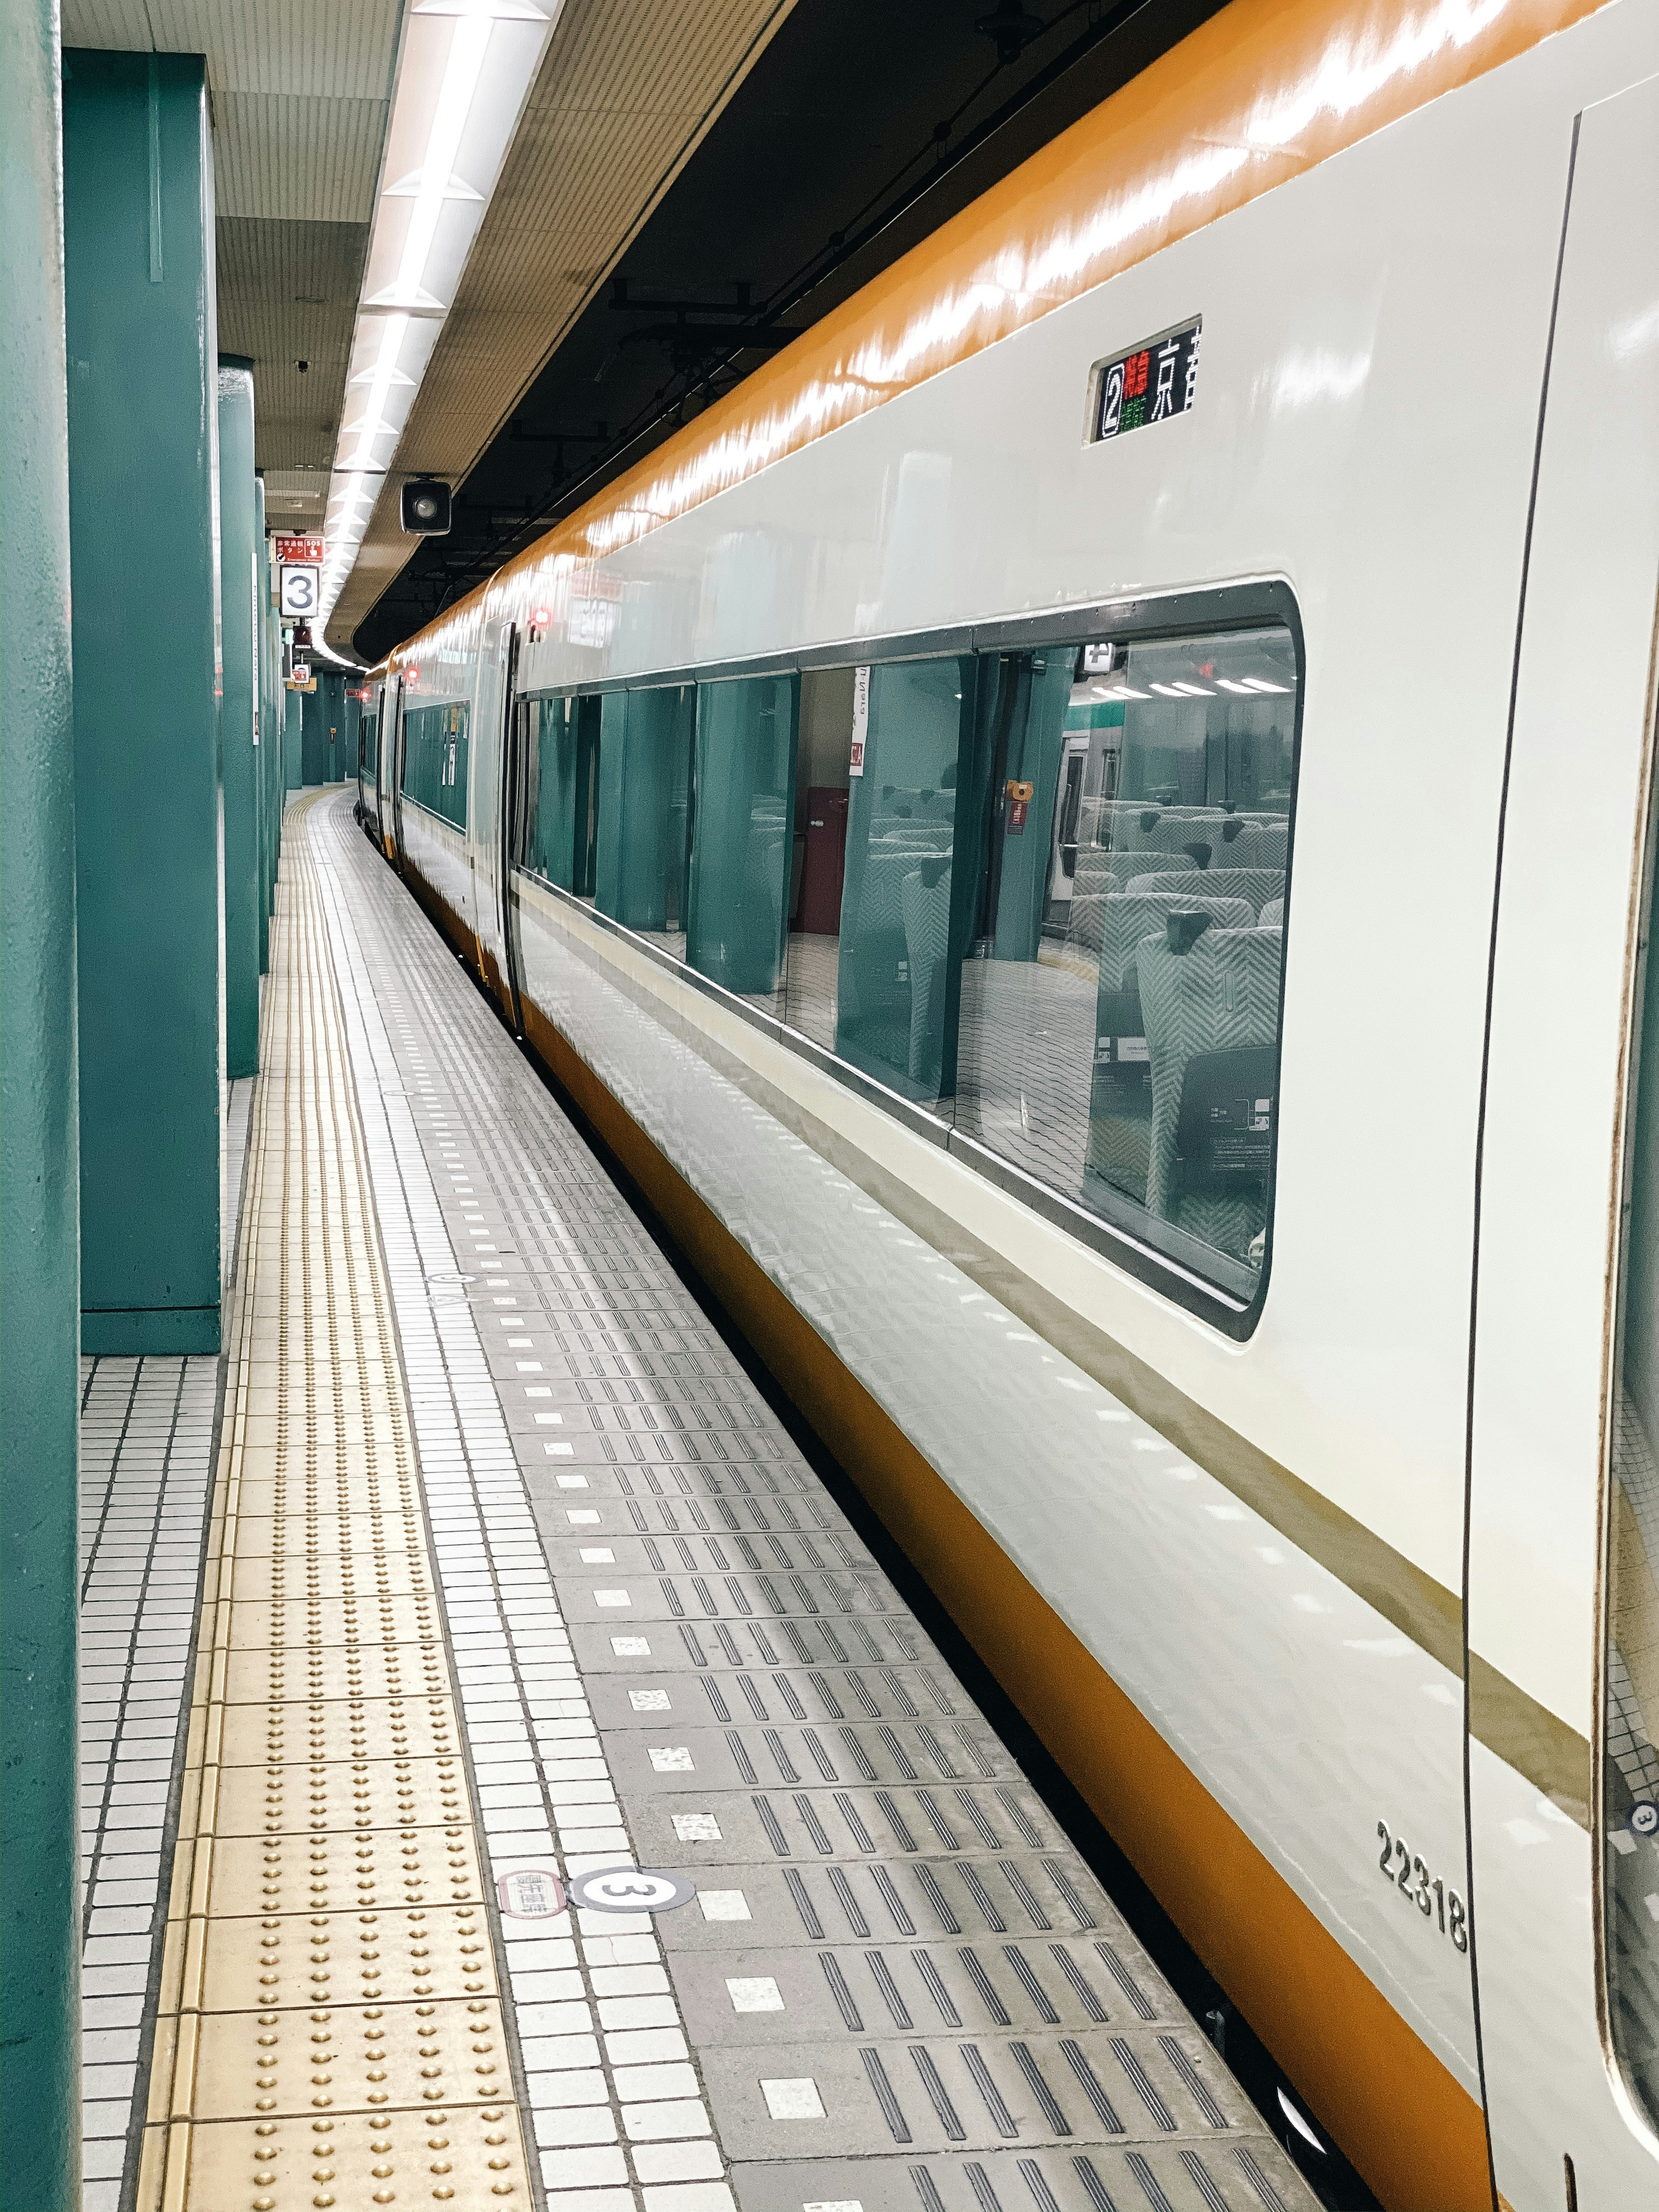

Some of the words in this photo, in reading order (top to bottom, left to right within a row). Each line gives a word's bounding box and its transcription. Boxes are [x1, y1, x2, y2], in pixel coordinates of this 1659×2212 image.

[1105, 374, 1121, 429] 2
[287, 575, 313, 609] 3
[602, 1884, 657, 1897] 3
[1377, 1819, 1467, 1953] 22318
